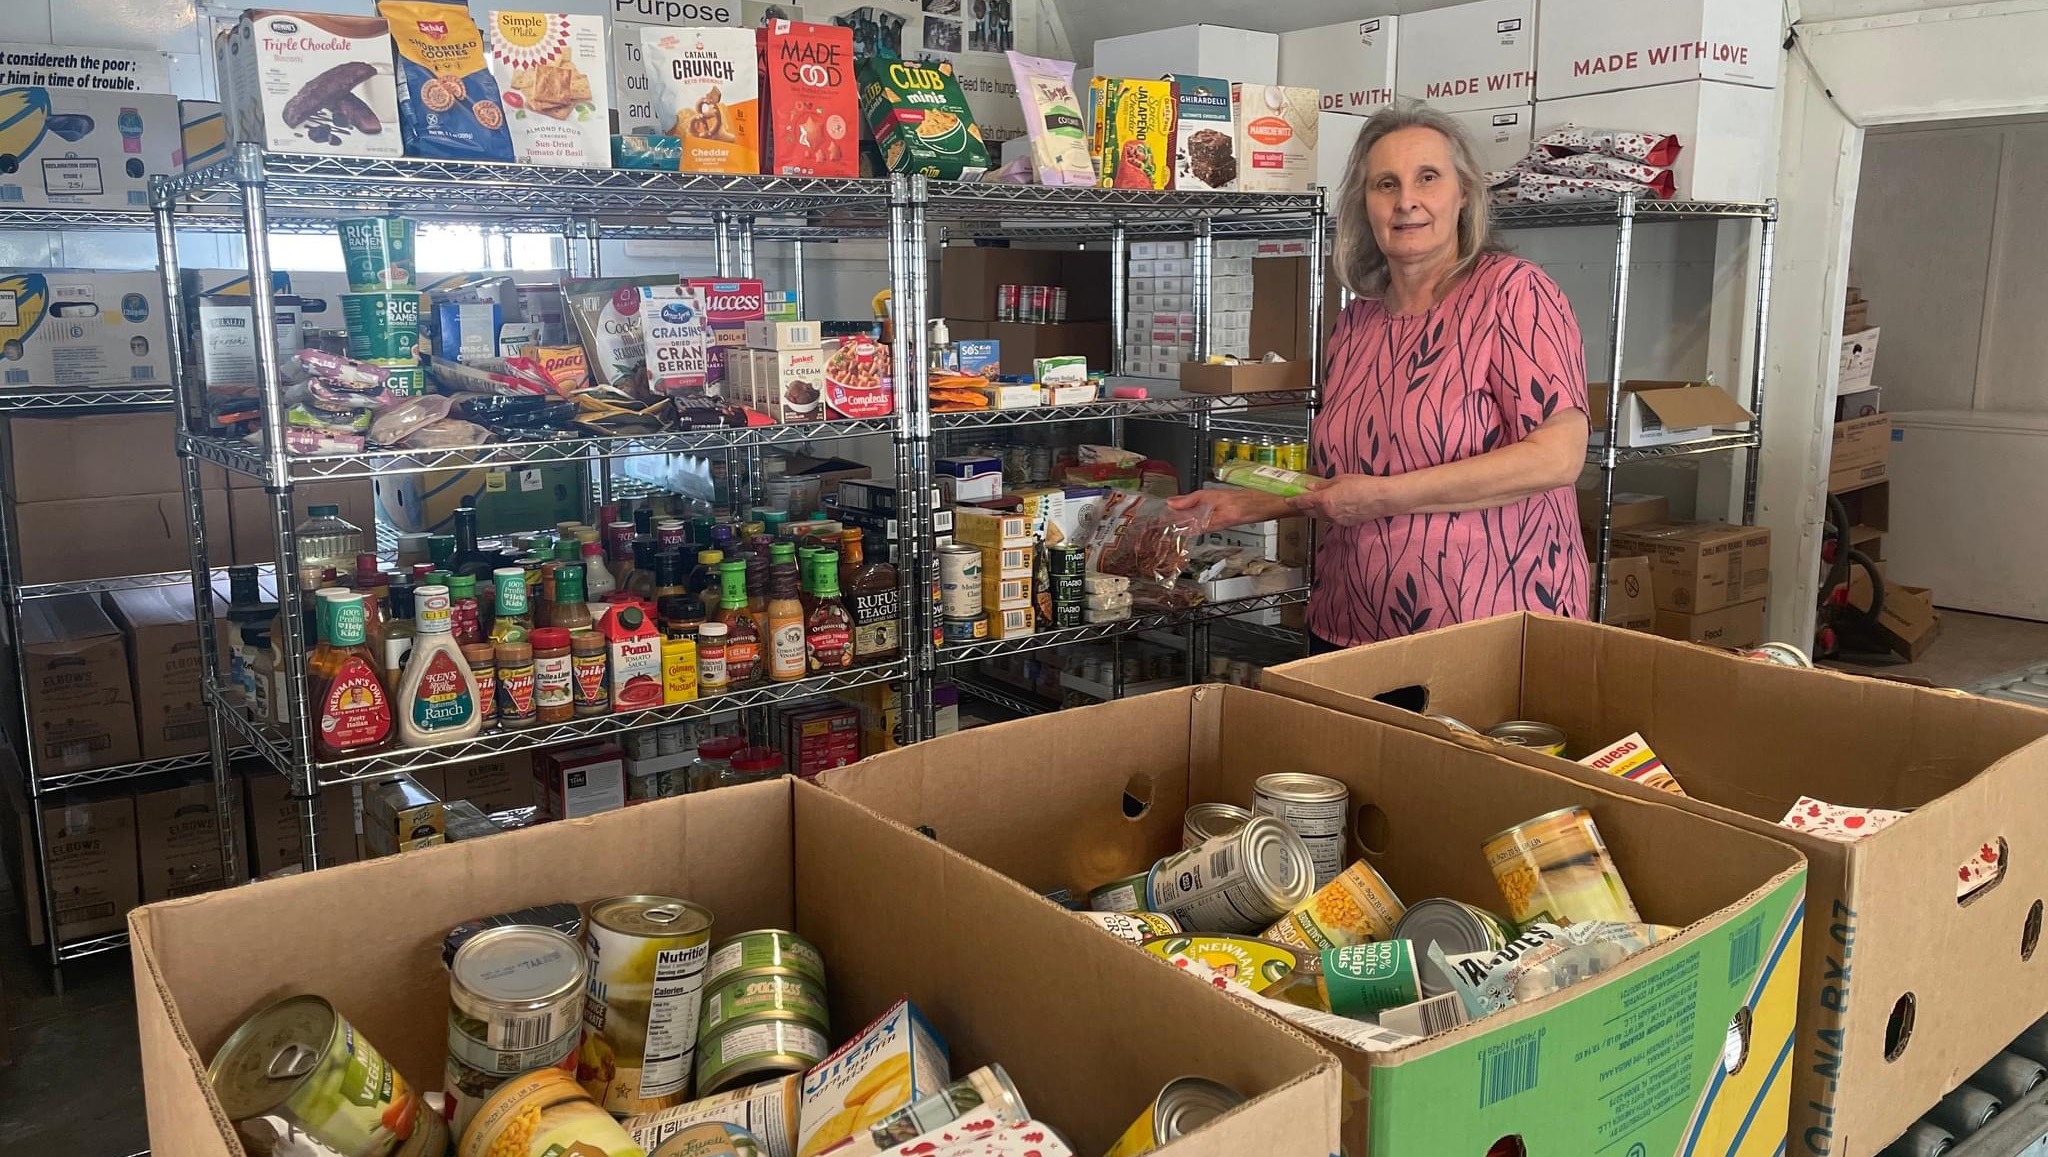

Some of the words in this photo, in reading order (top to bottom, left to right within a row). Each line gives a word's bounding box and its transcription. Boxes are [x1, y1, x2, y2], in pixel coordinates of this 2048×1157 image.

[615, 0, 729, 23] Purpose
[502, 15, 542, 29] Simple
[510, 27, 537, 37] Mills
[262, 38, 297, 54] Triple
[300, 38, 351, 51] Chocolate
[625, 43, 641, 62] To
[781, 40, 840, 66] MADE
[421, 49, 468, 58] COOKIES
[684, 51, 718, 60] CATALINA
[1574, 52, 1638, 77] MADE
[1648, 41, 1708, 66] WITH
[1713, 42, 1748, 66] LOVE
[7, 52, 78, 69] considereth
[80, 55, 100, 70] the
[672, 59, 735, 82] CRUNCH
[783, 63, 842, 88] GOOD
[889, 64, 945, 90] CLUB
[7, 72, 30, 85] him
[33, 72, 45, 86] in
[48, 73, 74, 88] time
[77, 74, 91, 88] of
[92, 76, 134, 91] trouble
[959, 78, 977, 92] Feed
[980, 78, 993, 92] the
[1426, 78, 1479, 99] MADE
[1487, 71, 1537, 93] WITH
[907, 91, 947, 104] minis
[1180, 95, 1226, 106] GHIRARDELLI
[1318, 92, 1343, 110] ADE
[1350, 88, 1392, 107] WITH
[629, 101, 651, 119] and
[1128, 92, 1139, 135] Cheddar
[692, 148, 729, 157] Cheddar
[346, 225, 381, 238] RICE
[349, 237, 382, 247] RAMEN
[386, 301, 417, 314] RICE
[707, 295, 760, 311] uccess
[388, 313, 417, 322] RAMEN
[652, 327, 703, 339] CRAISINS
[657, 347, 702, 361] CRAN
[658, 361, 704, 373] BERRIE
[796, 368, 820, 376] CREAM
[847, 394, 889, 407] Compleats
[1058, 606, 1081, 614] MARIO
[340, 628, 360, 638] Kids
[1704, 627, 1723, 640] Food
[165, 657, 202, 671] ELBOW
[625, 655, 651, 663] TOMATO
[426, 671, 457, 683] KEN'S
[669, 678, 697, 692] Mustard
[425, 704, 464, 720] Ranch
[1592, 742, 1638, 769] queso
[1198, 942, 1256, 990] NEWMAN'S
[1350, 946, 1365, 975] Help
[654, 986, 684, 996] Calories
[806, 1013, 902, 1095] JIFFY
